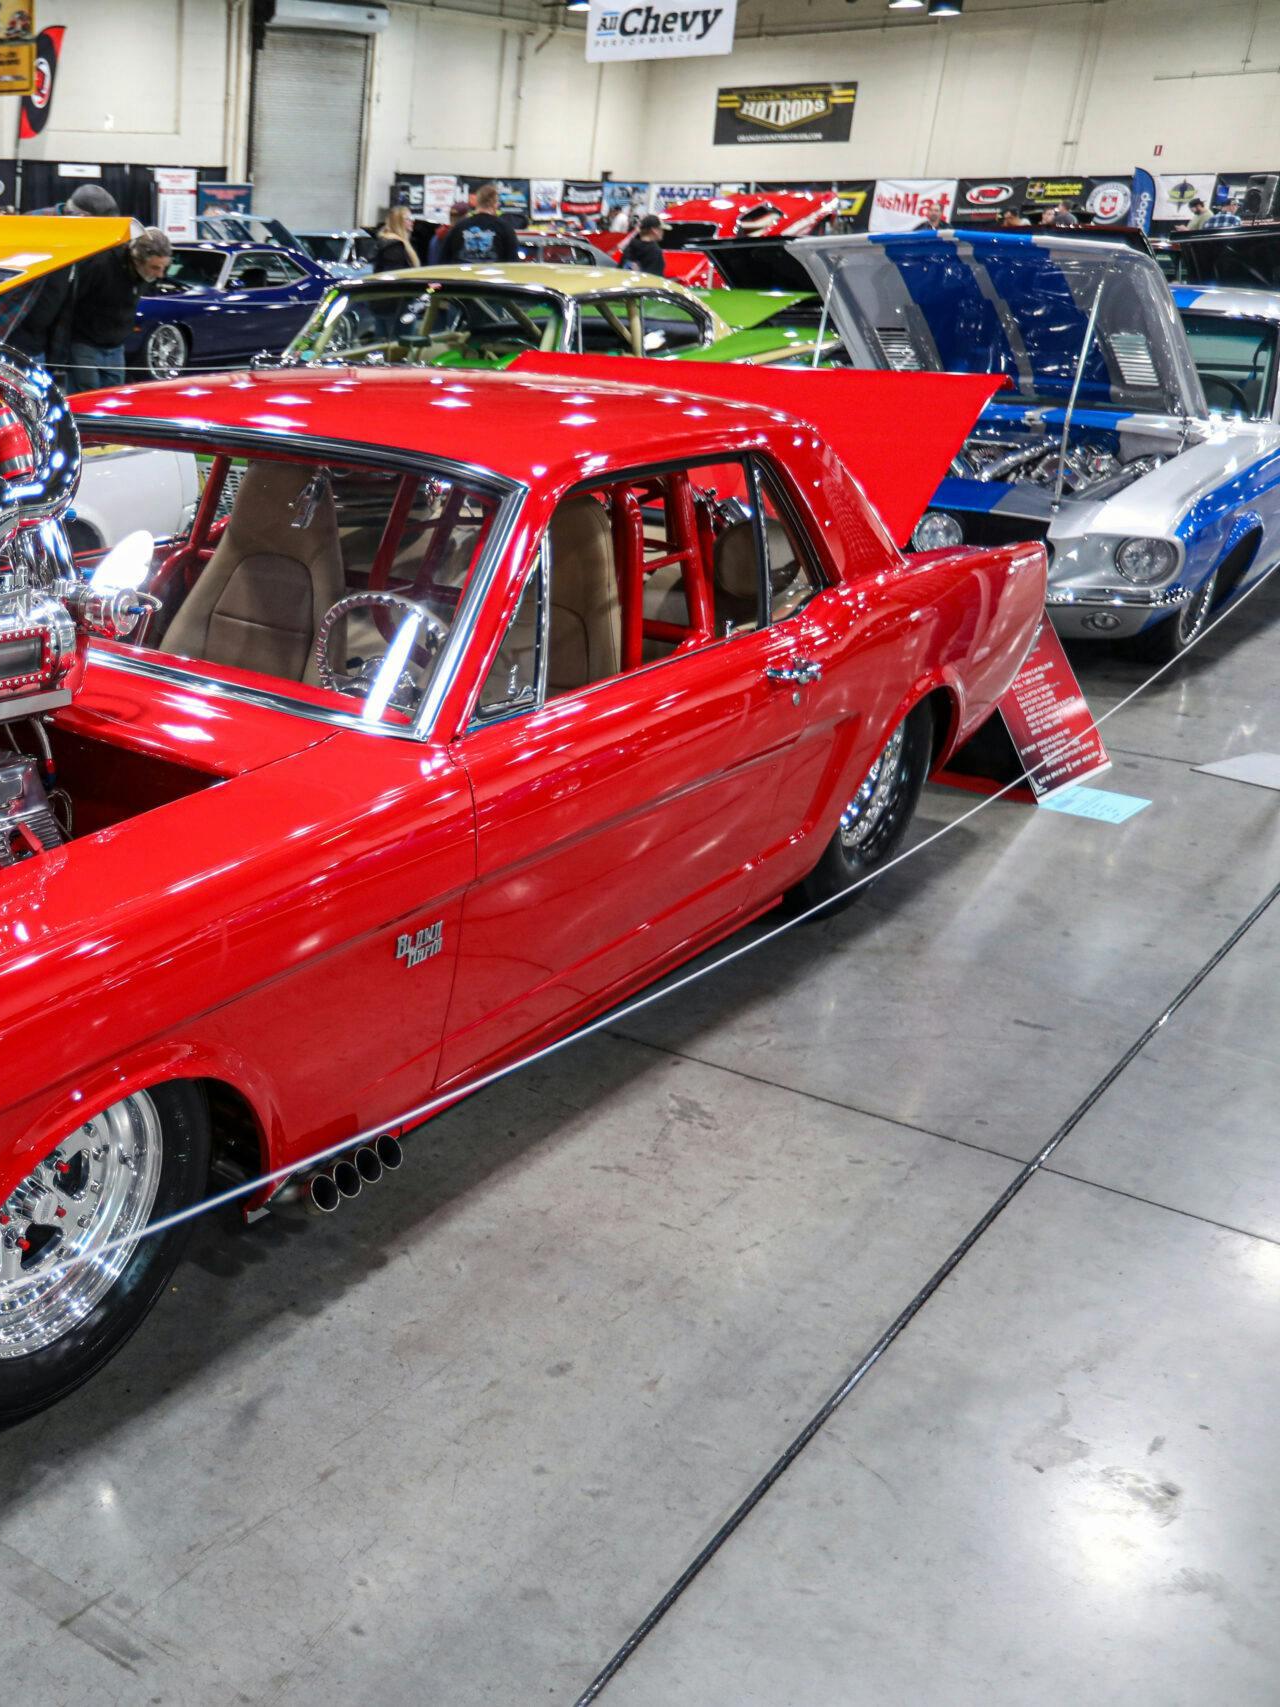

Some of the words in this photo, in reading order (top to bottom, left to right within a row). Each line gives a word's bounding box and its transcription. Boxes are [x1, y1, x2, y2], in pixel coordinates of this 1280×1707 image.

[597, 16, 618, 31] All
[620, 6, 723, 40] Chevy
[594, 34, 693, 47] PERFORMANCE
[396, 920, 443, 958] BLOWN
[407, 936, 443, 968] MAFIA
